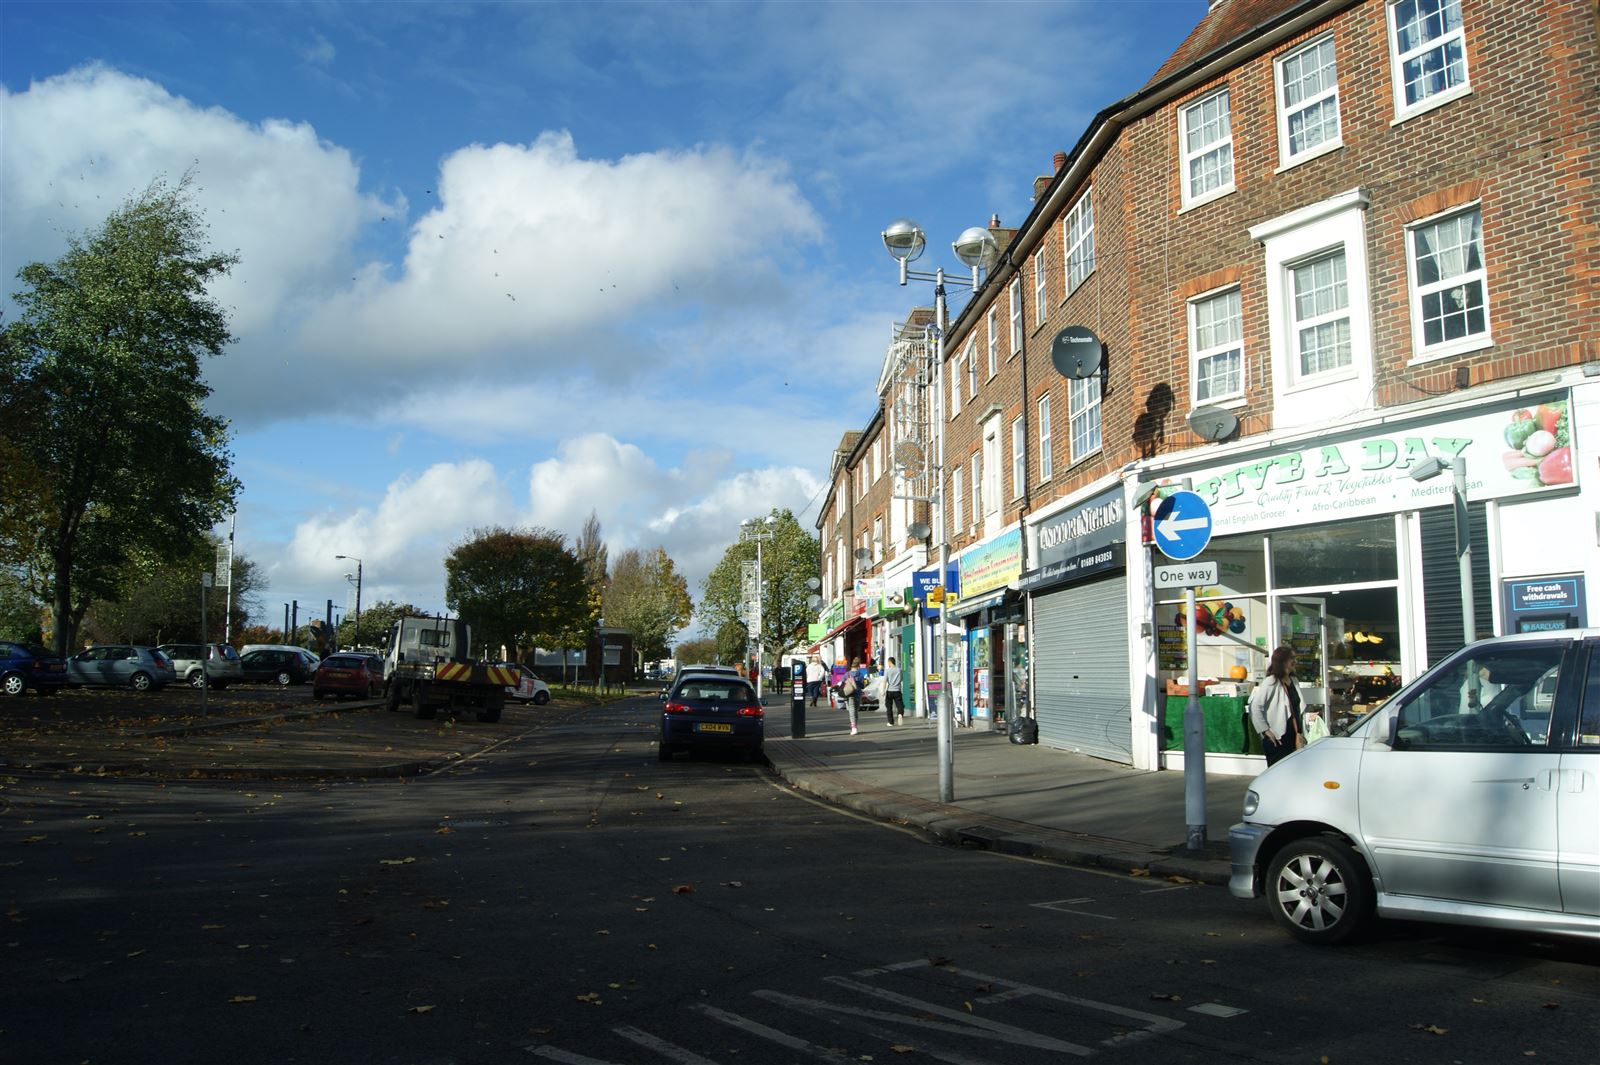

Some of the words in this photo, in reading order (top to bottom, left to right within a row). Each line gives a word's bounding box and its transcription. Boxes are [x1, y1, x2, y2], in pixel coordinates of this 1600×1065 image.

[1195, 452, 1305, 507] FIVE
[1314, 445, 1350, 477] A
[1360, 436, 1474, 471] DAY
[1232, 512, 1259, 525] English
[1260, 510, 1286, 520] Grocer
[1311, 496, 1377, 512] Afro-Caribbean
[1411, 480, 1483, 497] Mediterrean
[1256, 488, 1293, 507] Quality
[1295, 484, 1322, 501] Fruit
[1336, 473, 1393, 496] Vegetables
[1160, 571, 1184, 582] One
[1187, 569, 1212, 581] way
[1522, 591, 1568, 601] withdrawals
